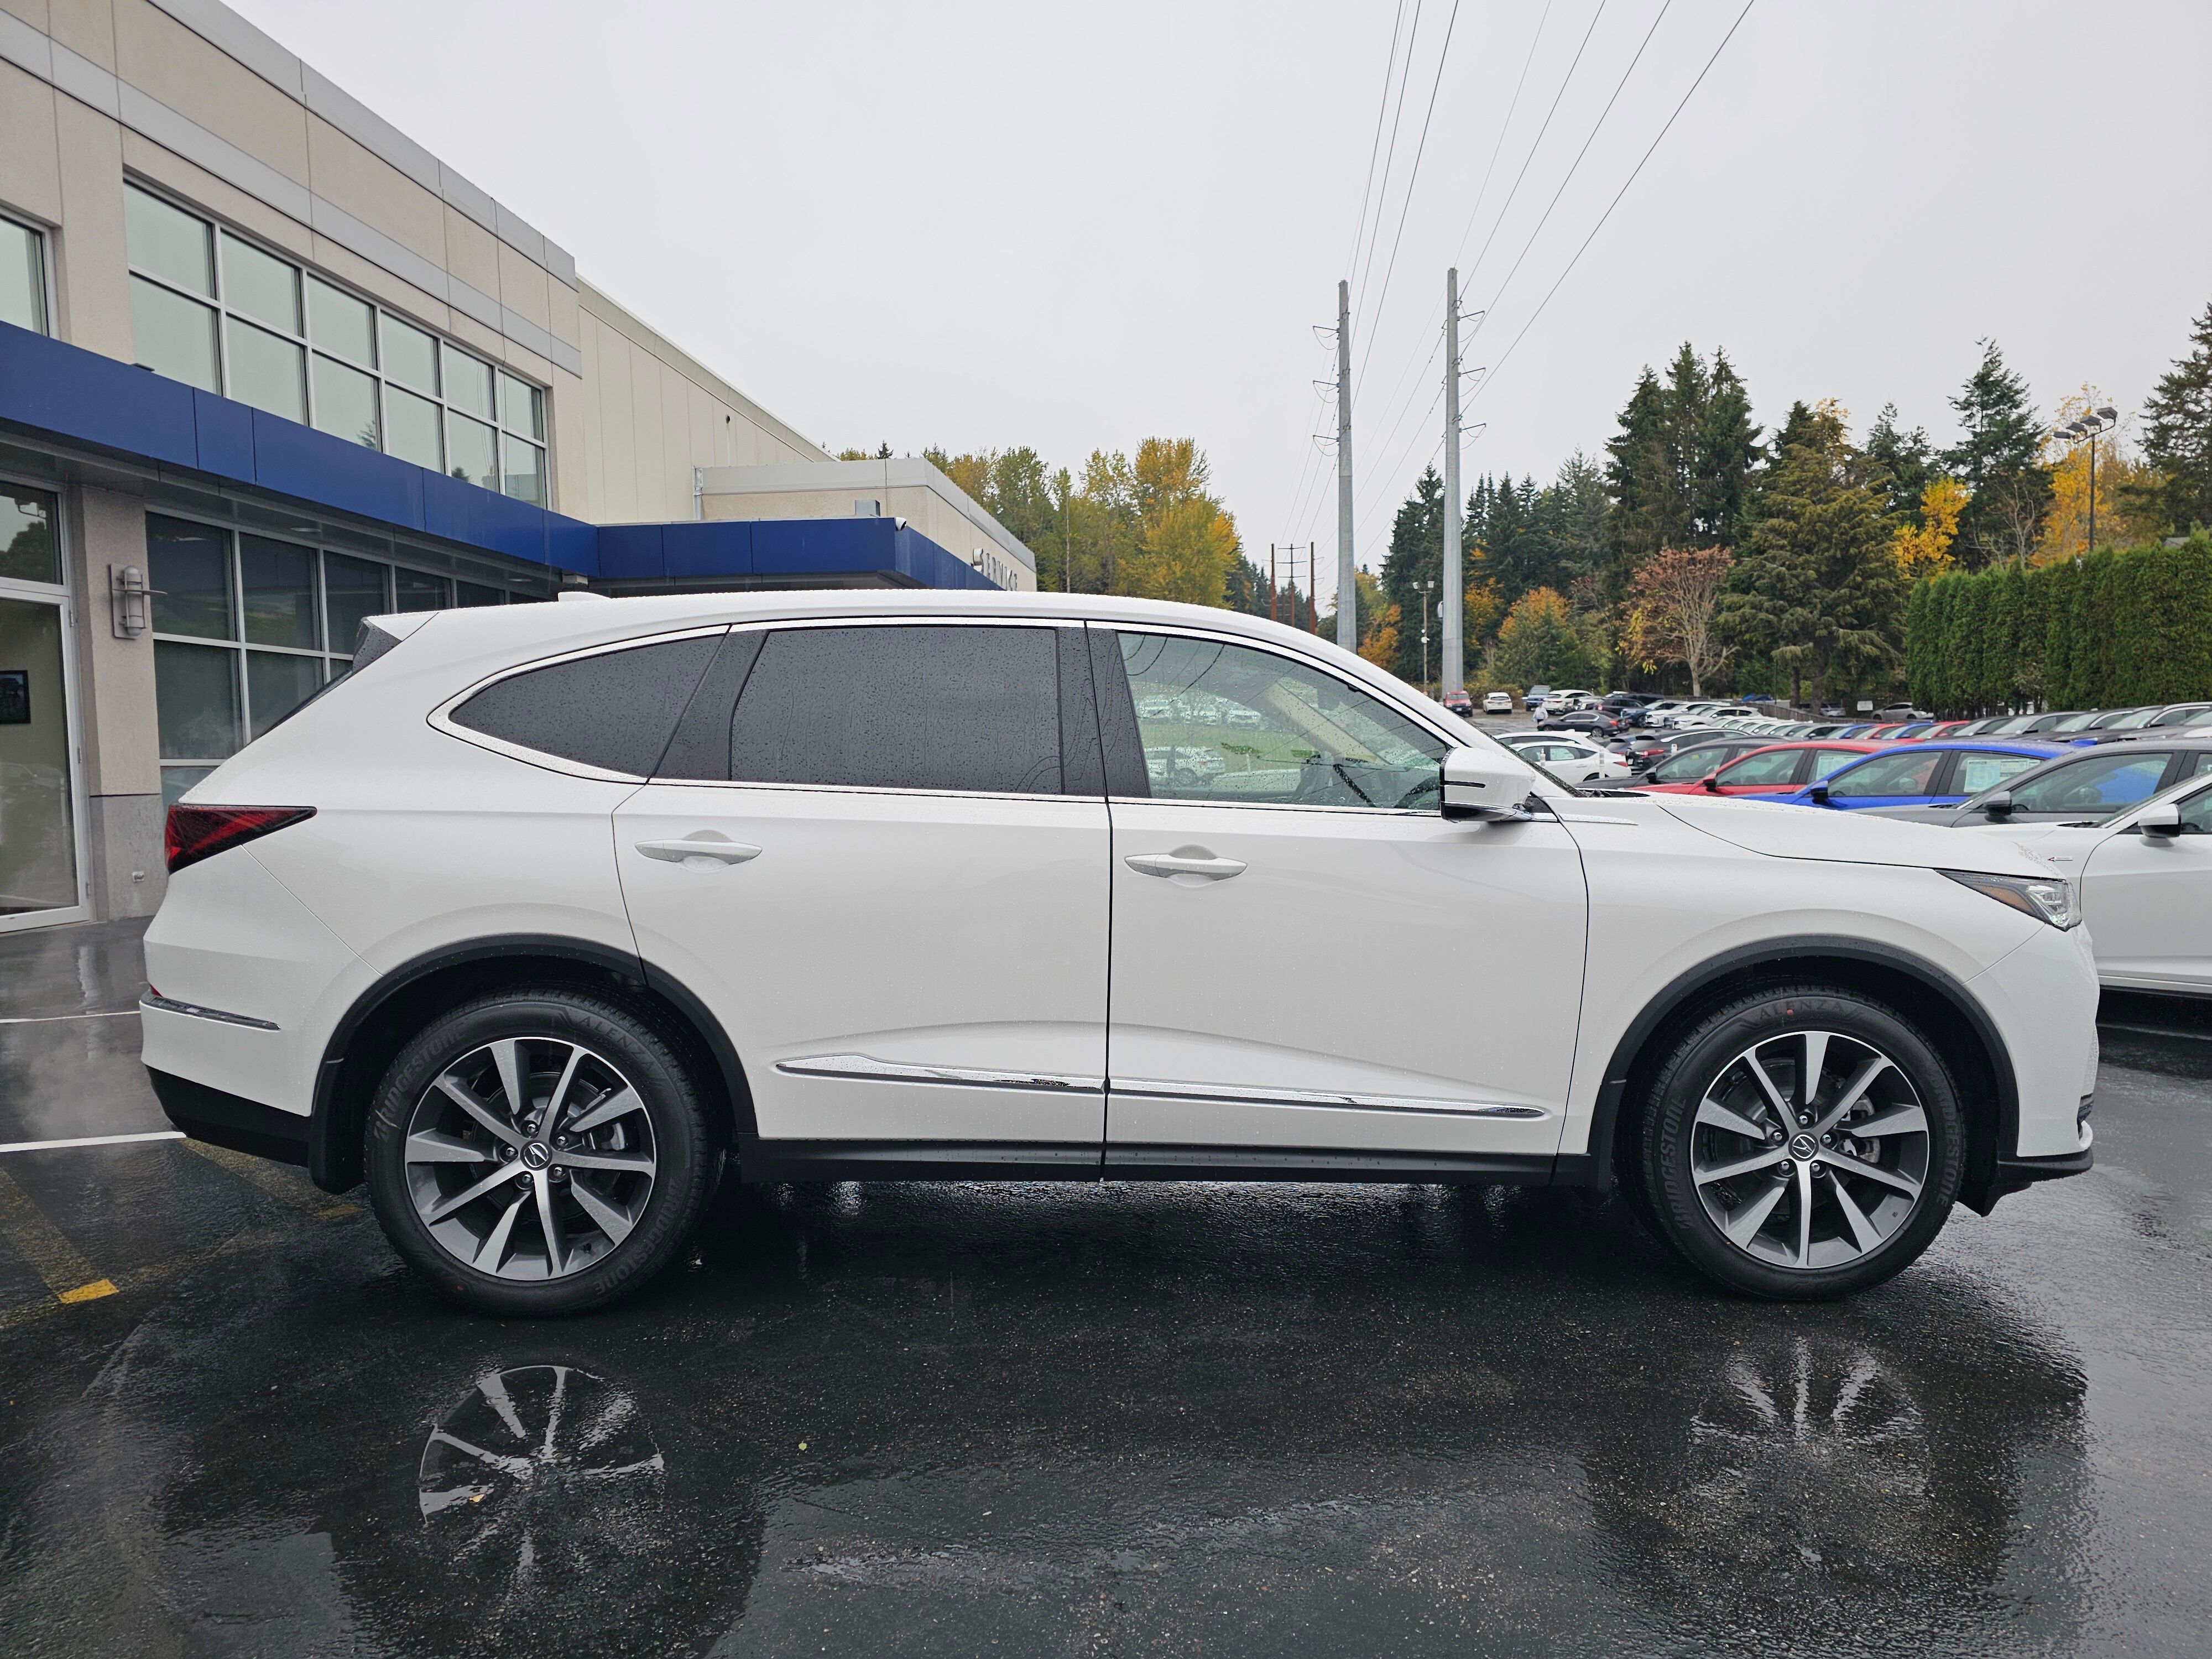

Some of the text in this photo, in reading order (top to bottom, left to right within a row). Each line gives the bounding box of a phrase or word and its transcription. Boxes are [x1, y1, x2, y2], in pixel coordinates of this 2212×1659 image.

[973, 548, 1017, 591] SERVICE
[577, 1016, 654, 1071] ALENZA
[1760, 1000, 1844, 1020] ALENZA
[374, 1021, 468, 1142] BRIDGESTONE
[1927, 1068, 1959, 1208] BRIDGESTONE
[1660, 1095, 1697, 1230] BRIDGESTONE
[592, 1176, 687, 1295] BRIDGESTONE
